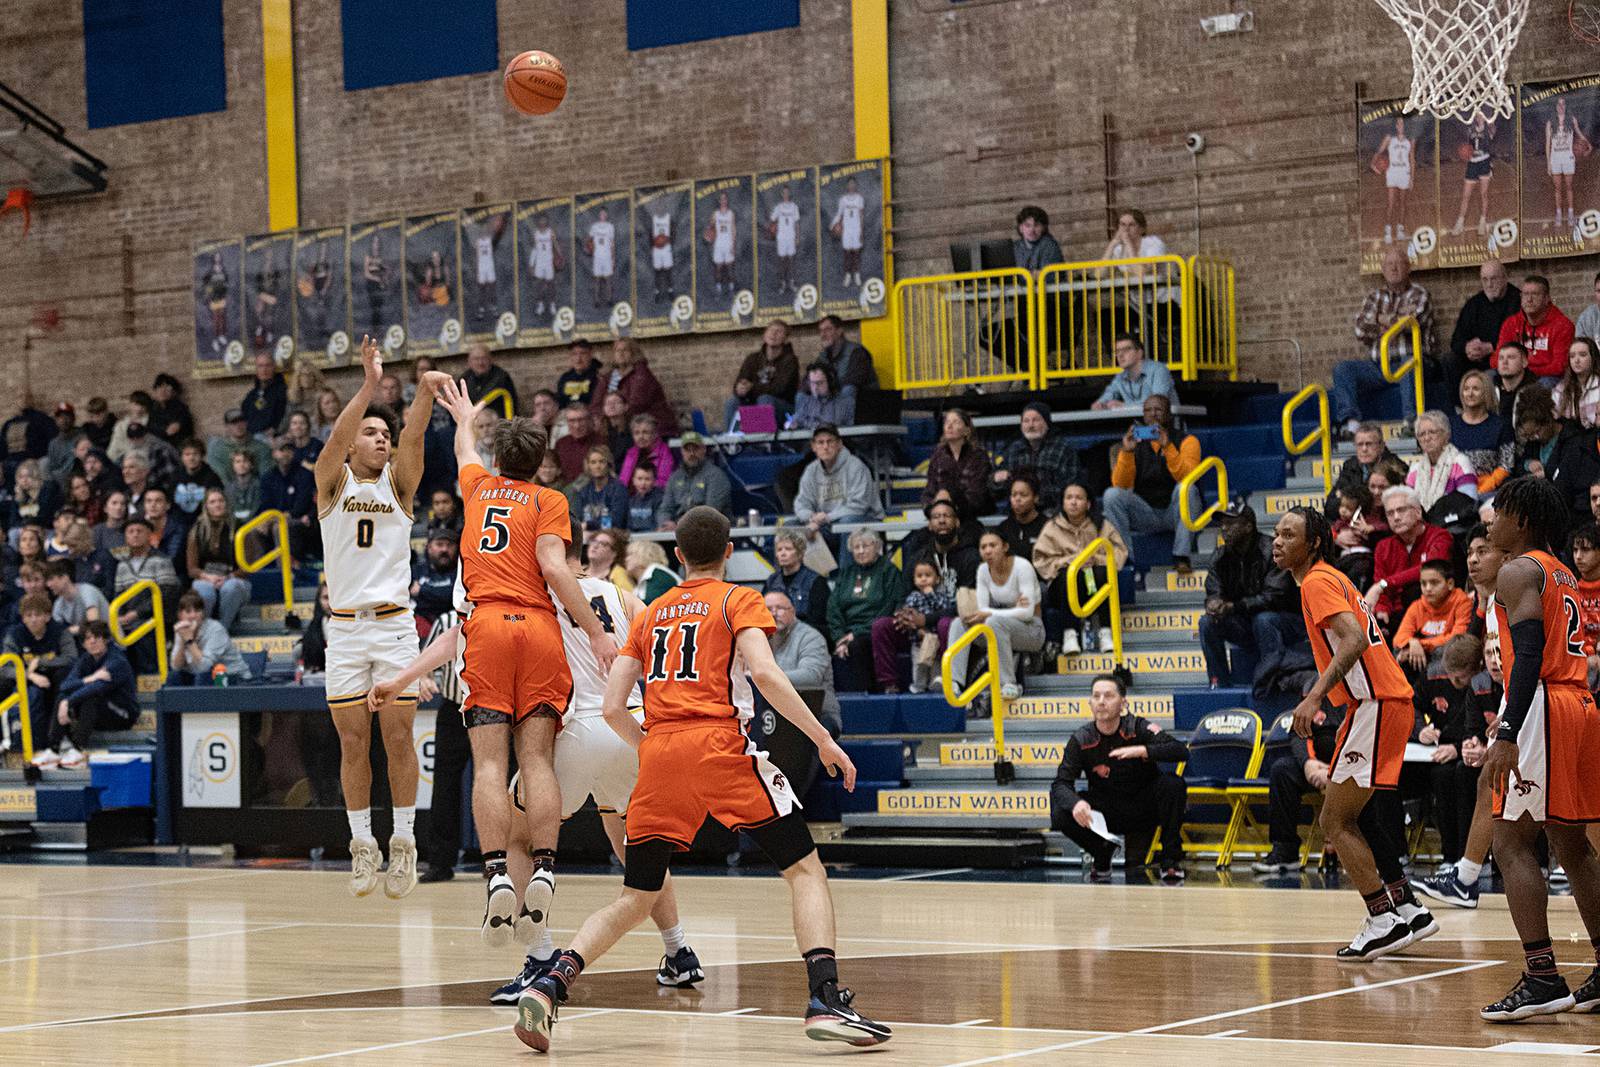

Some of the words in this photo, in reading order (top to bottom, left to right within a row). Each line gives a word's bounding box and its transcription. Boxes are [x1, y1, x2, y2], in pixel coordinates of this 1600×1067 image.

[343, 496, 395, 513] Warriors
[479, 487, 531, 506] PANTHERS
[355, 518, 374, 549] 0
[477, 505, 515, 554] 5
[655, 601, 710, 622] PANTHERS
[1122, 615, 1193, 629] GOLDEN
[646, 621, 702, 683] 11
[1067, 656, 1138, 671] GOLDN
[1147, 655, 1202, 670] WARR
[1008, 702, 1080, 716] GOLDEN
[1204, 714, 1251, 730] GOLDEN
[208, 741, 227, 773] S
[951, 748, 1023, 760] GOLDN
[887, 796, 961, 809] GOLDEN
[969, 796, 1048, 810] WARRIO
